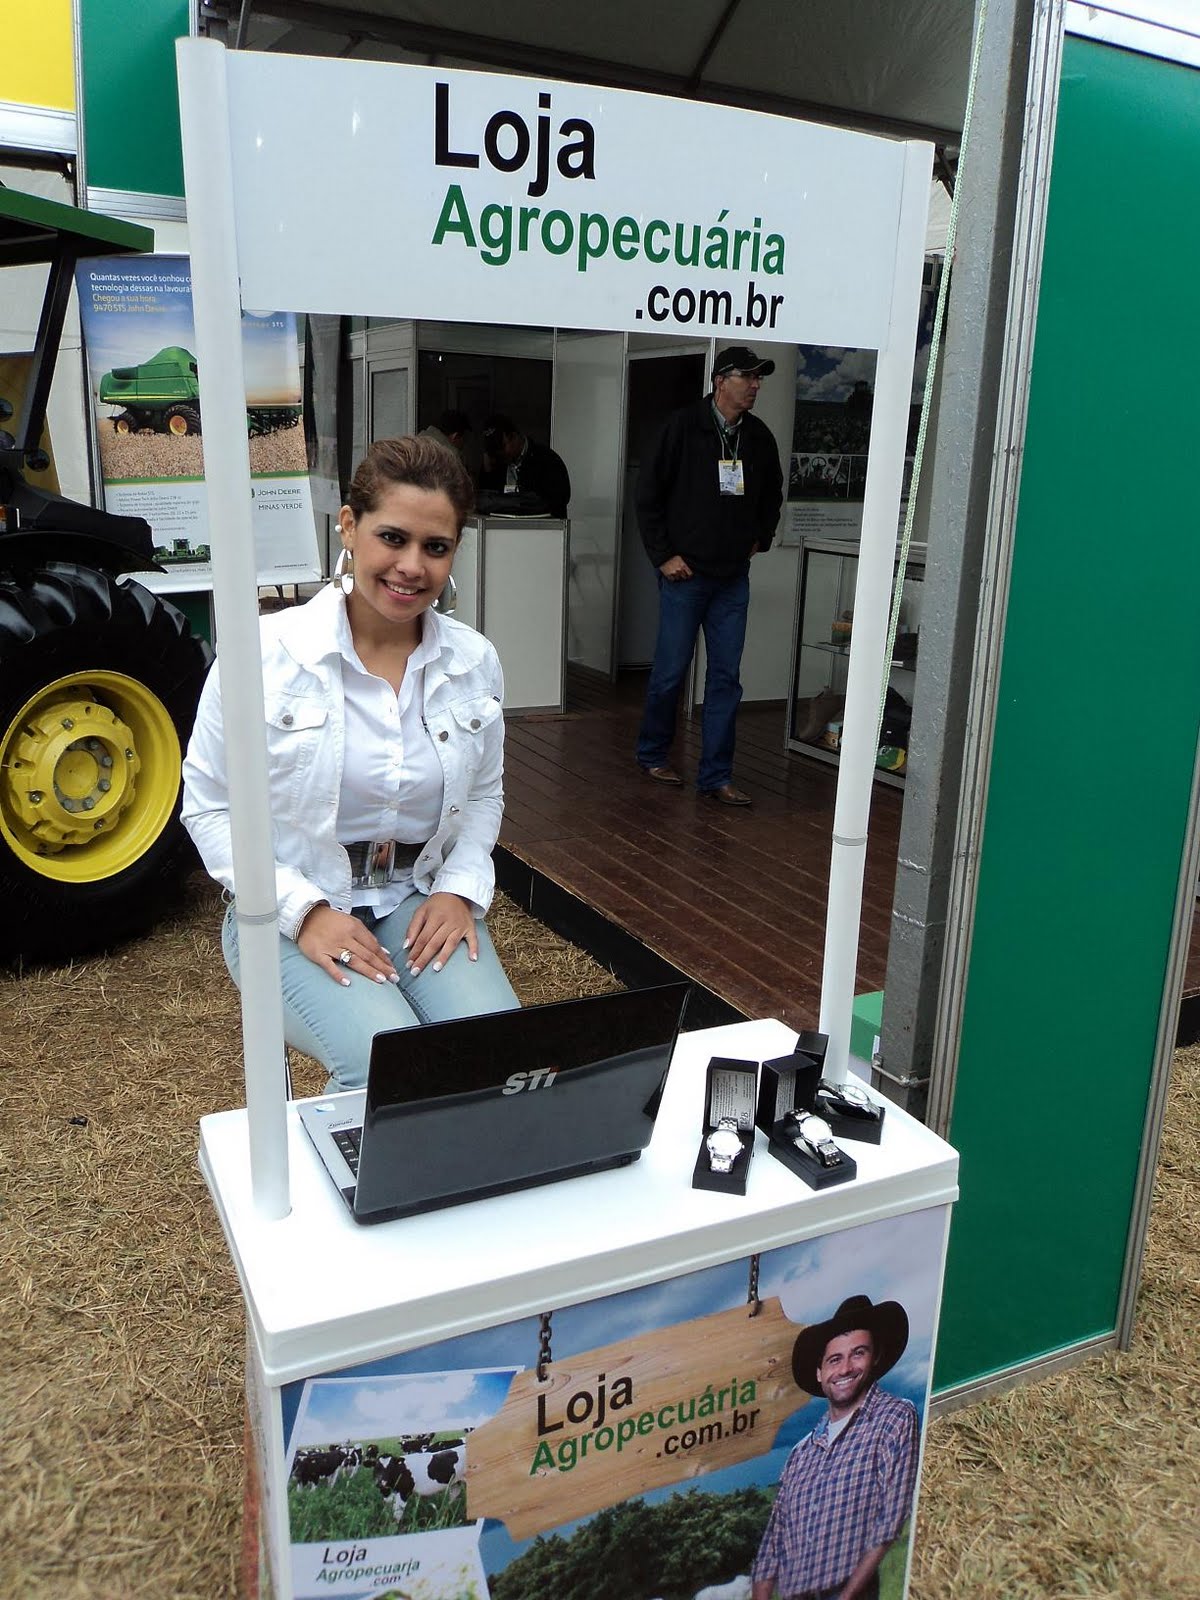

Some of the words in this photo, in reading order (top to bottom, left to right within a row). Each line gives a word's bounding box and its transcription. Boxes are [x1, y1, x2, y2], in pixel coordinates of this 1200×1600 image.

[435, 82, 596, 198] Loja
[431, 184, 785, 275] Agropecuária
[90, 273, 120, 281] Quantas
[140, 274, 158, 282] você
[159, 274, 184, 283] sonhou
[91, 284, 129, 293] tecnologia
[130, 284, 153, 292] dessas
[92, 294, 120, 304] Chegou
[635, 281, 784, 329] .com.br
[281, 502, 303, 510] VERDE
[529, 1377, 757, 1477] Agropecuária
[537, 1373, 633, 1437] Loja
[655, 1408, 761, 1459] .com.br
[322, 1544, 368, 1567] Loja
